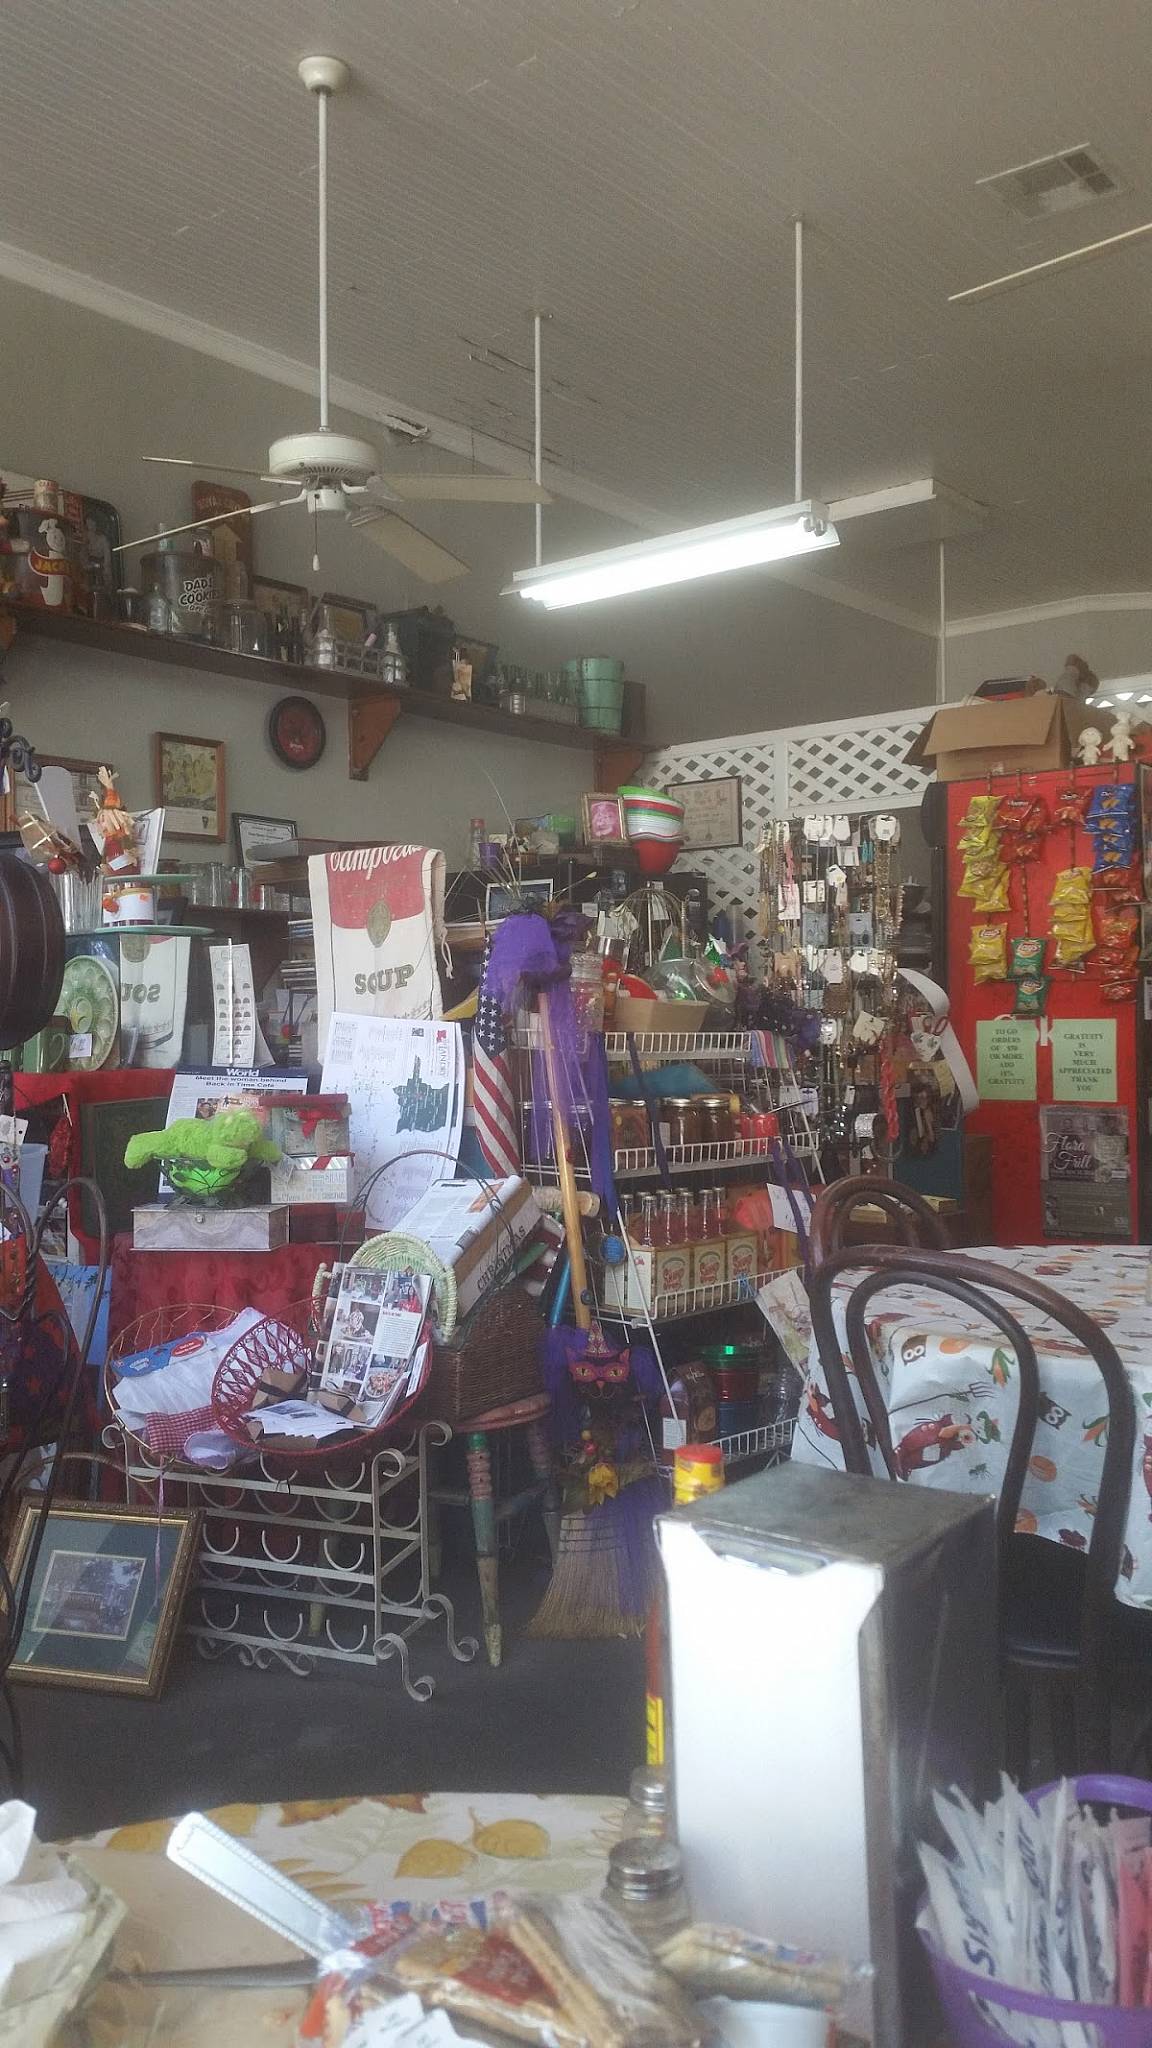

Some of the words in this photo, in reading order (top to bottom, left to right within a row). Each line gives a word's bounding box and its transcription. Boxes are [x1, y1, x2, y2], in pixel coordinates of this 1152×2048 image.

[355, 963, 415, 995] SOUP
[226, 1068, 260, 1077] World
[1041, 1132, 1086, 1153] Flora
